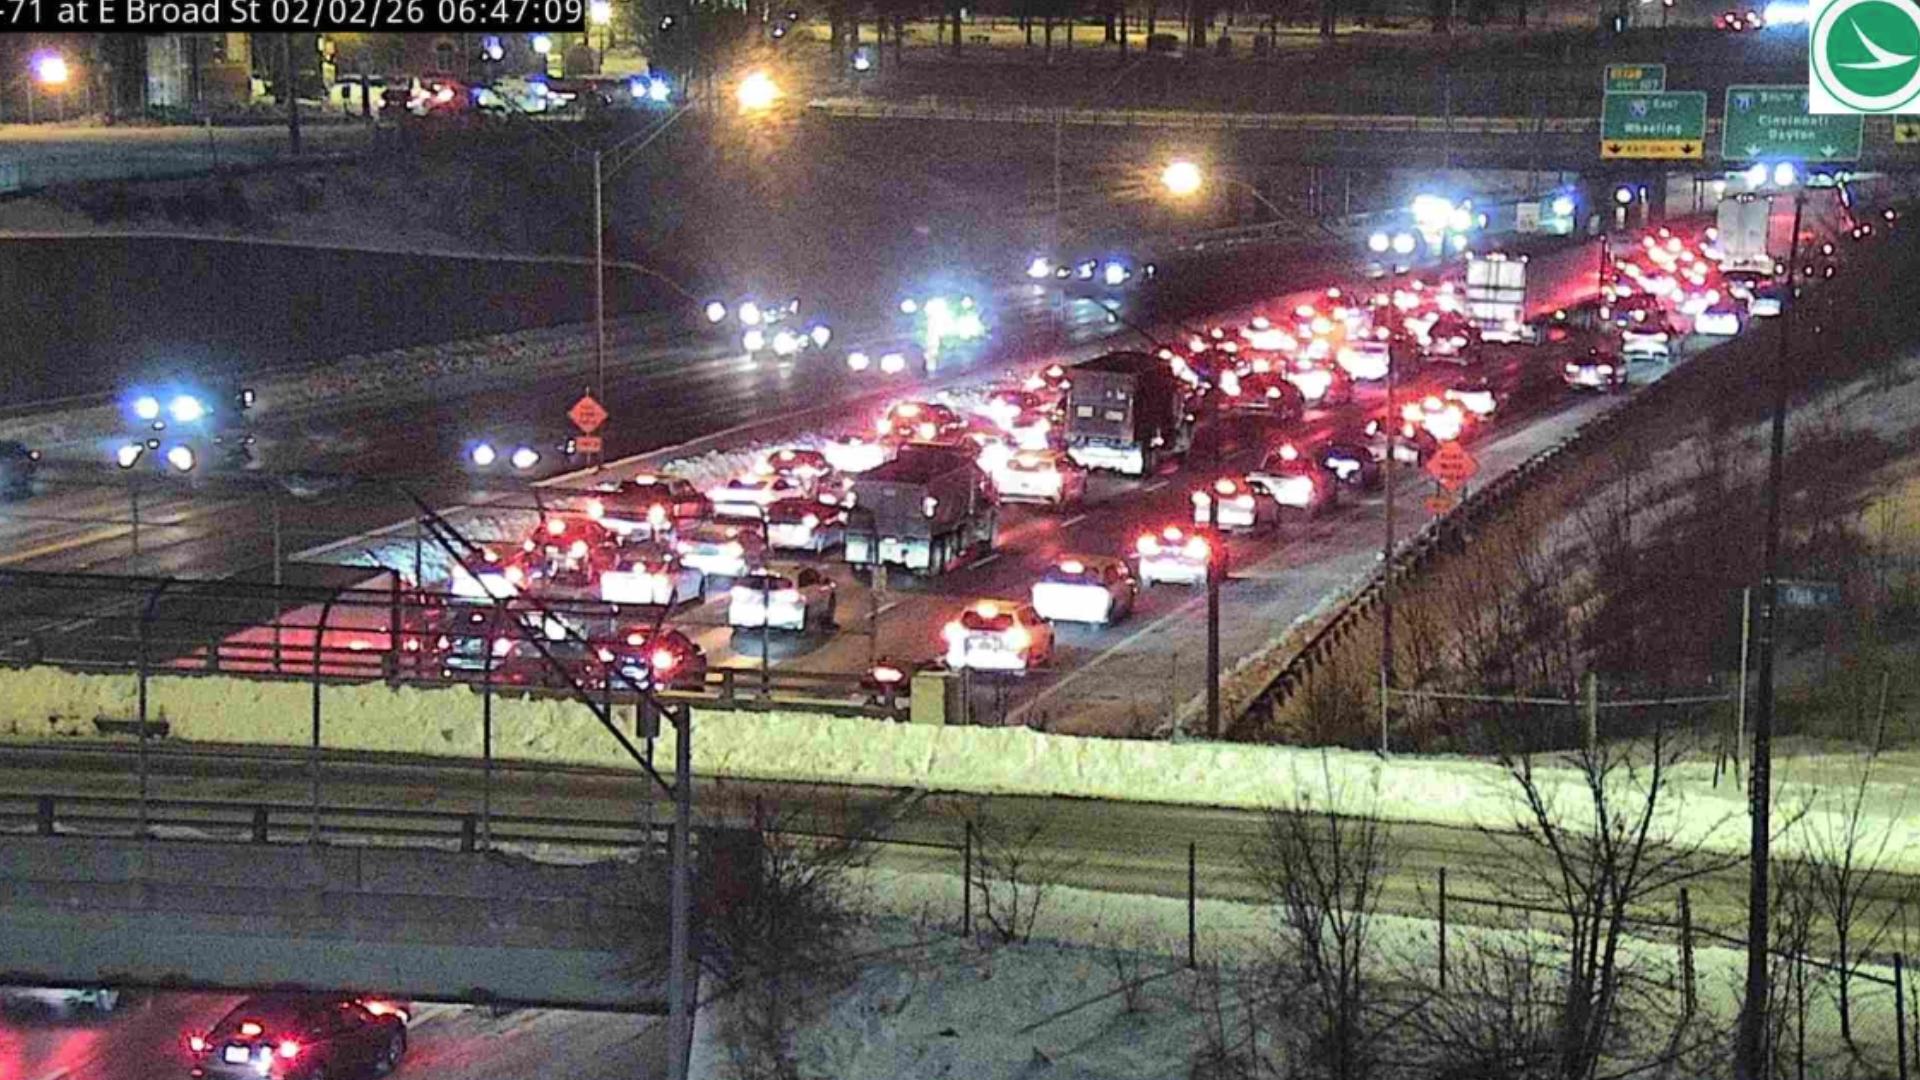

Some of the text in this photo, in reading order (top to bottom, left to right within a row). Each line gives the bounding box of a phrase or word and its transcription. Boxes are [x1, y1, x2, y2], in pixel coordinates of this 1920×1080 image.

[1759, 115, 1829, 126] Cincinnati
[1624, 122, 1681, 136] Wheeling
[1769, 130, 1816, 141] Dayton
